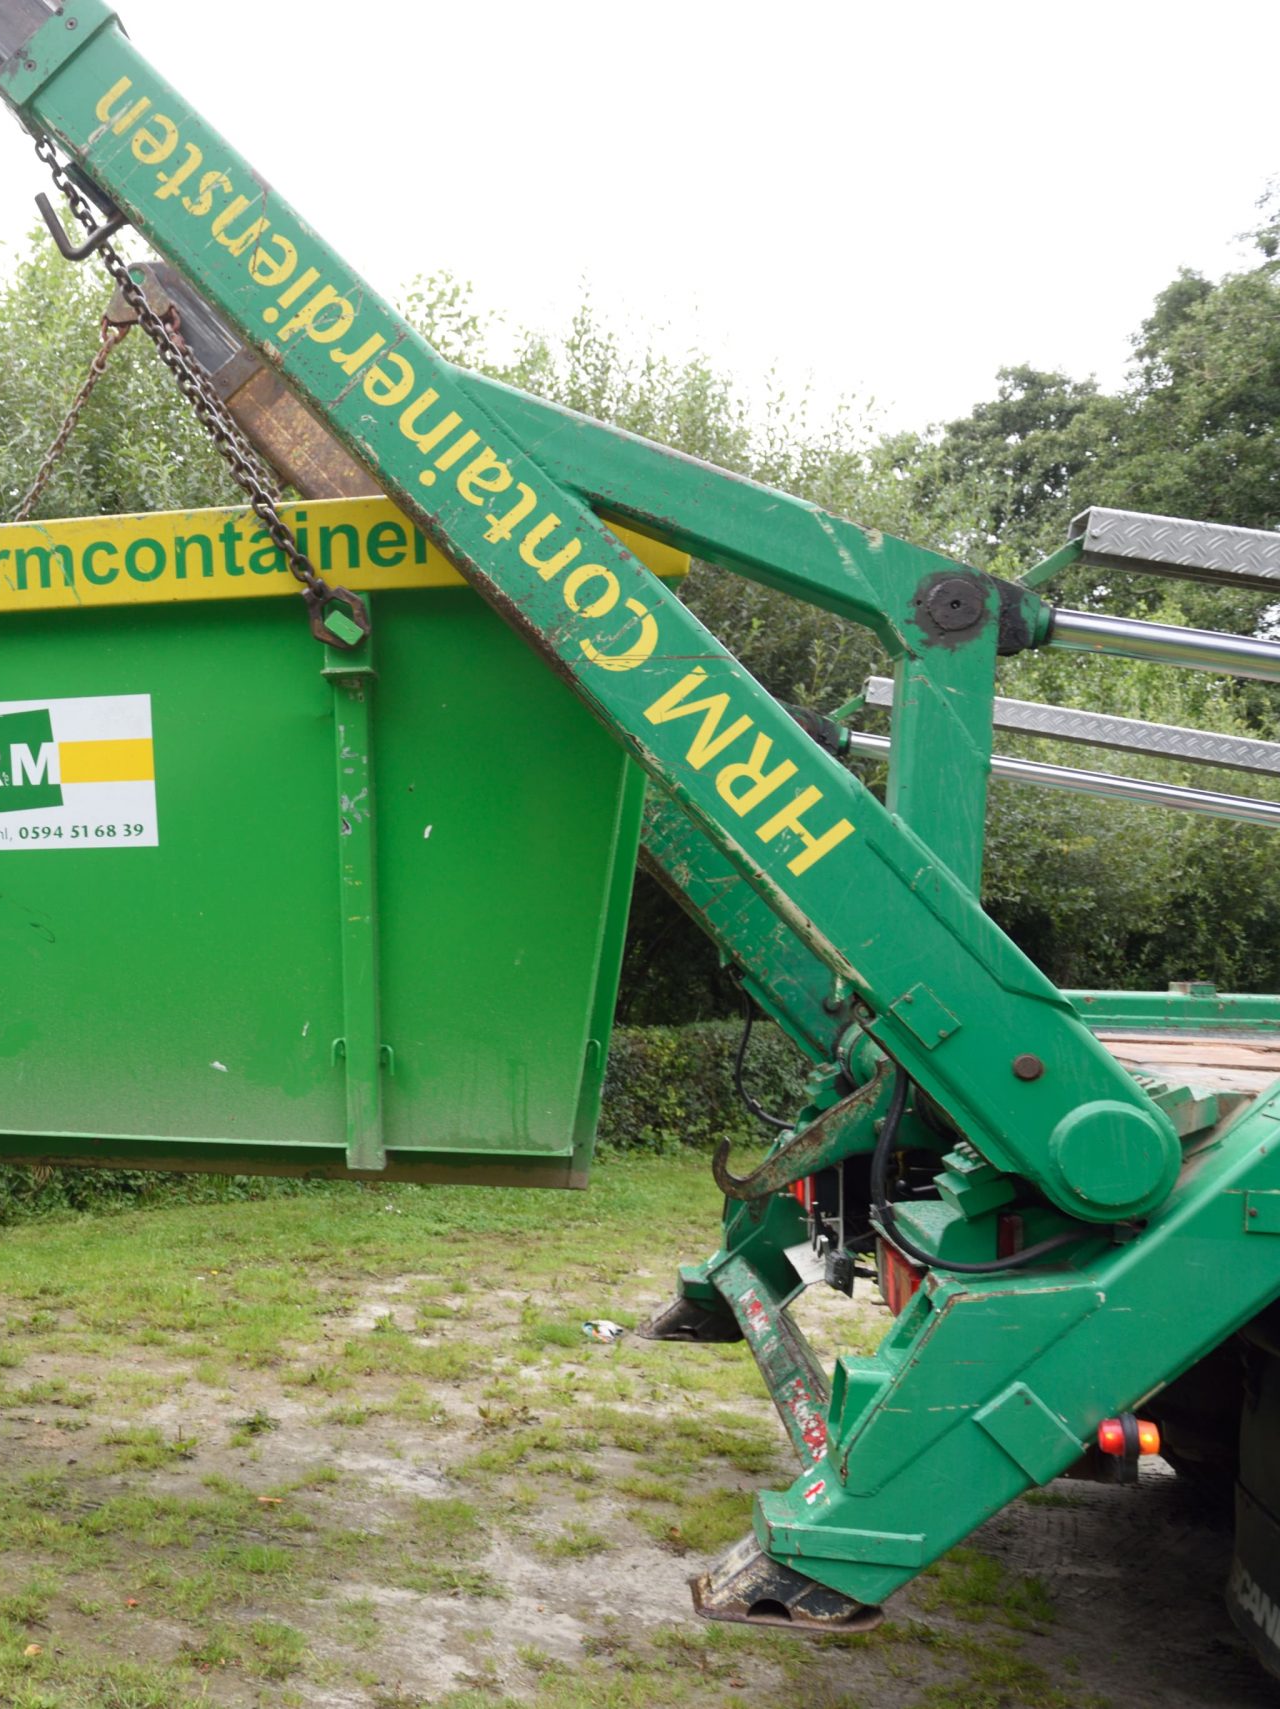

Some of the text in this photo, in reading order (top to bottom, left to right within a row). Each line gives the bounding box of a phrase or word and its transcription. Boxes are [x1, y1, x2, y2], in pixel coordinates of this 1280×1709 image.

[95, 75, 856, 877] HRM Containerdiensten
[18, 826, 64, 840] 0594
[70, 825, 89, 839] 51
[94, 824, 117, 838] 68
[122, 823, 145, 838] 39
